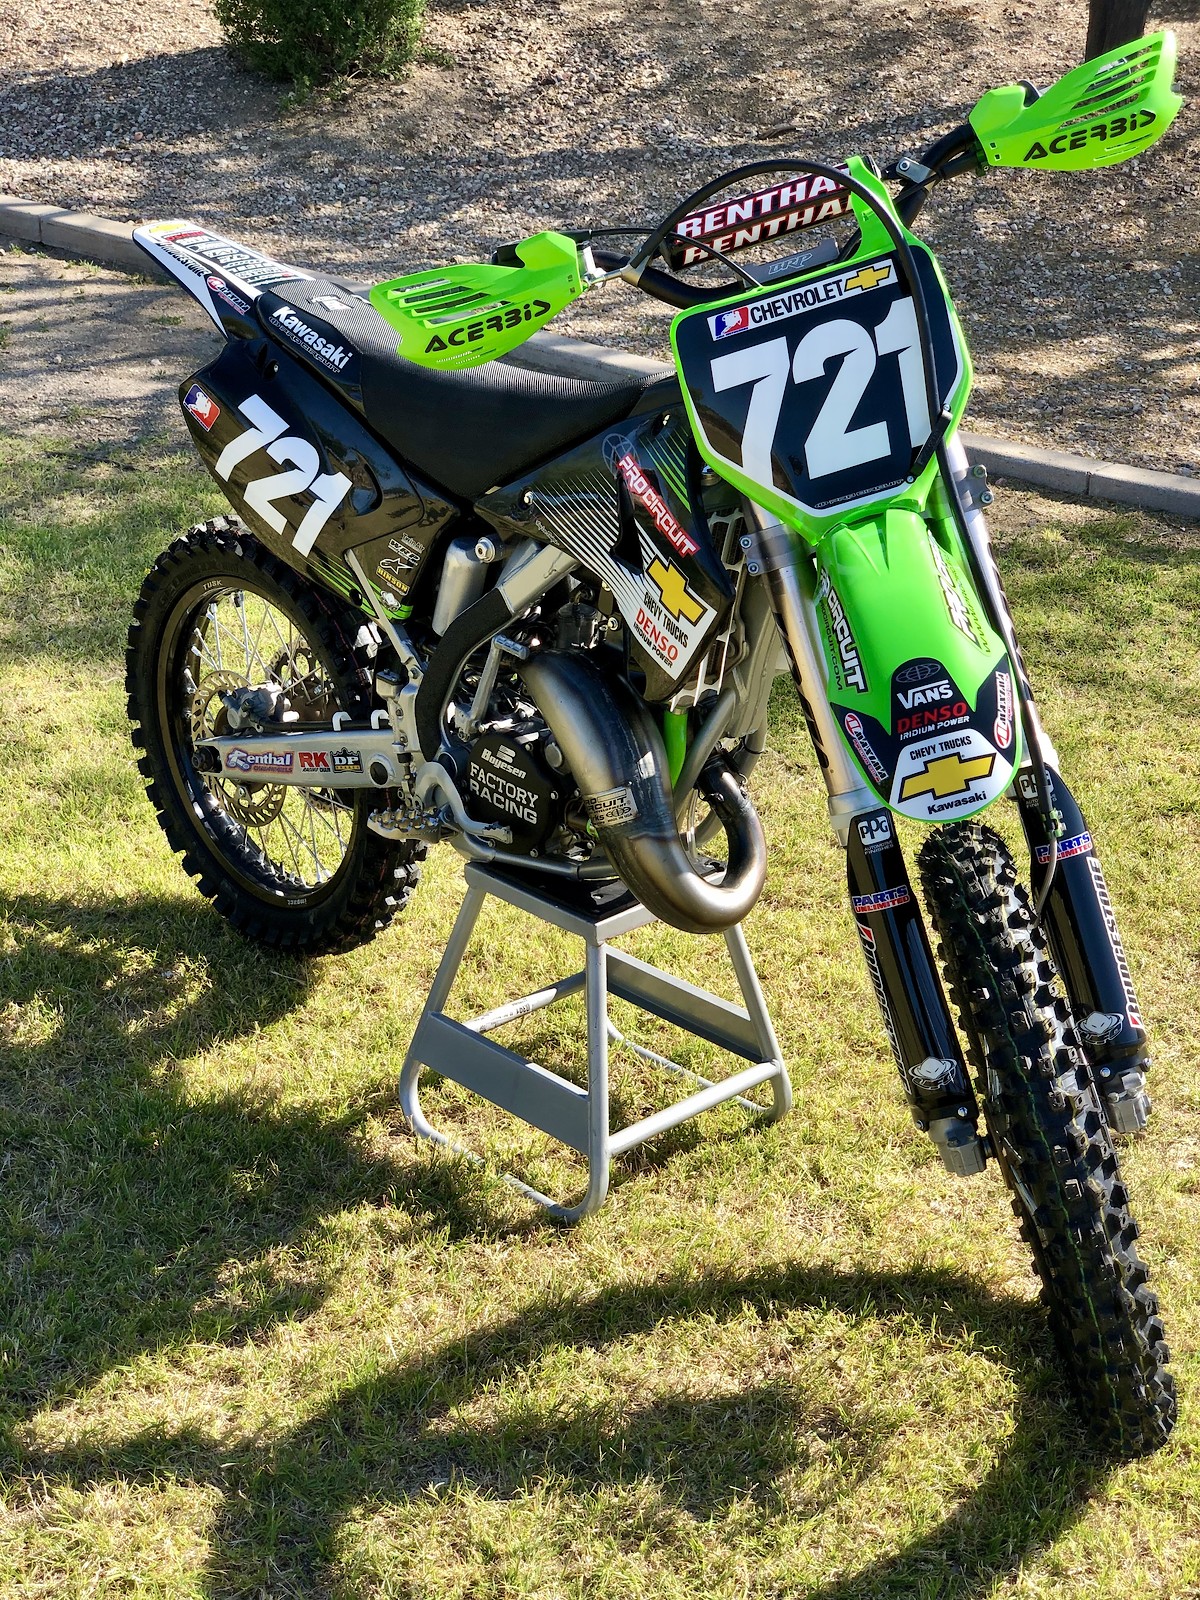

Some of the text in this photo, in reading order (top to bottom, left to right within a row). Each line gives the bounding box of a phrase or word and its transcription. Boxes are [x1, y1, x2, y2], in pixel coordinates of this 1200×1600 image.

[1023, 109, 1156, 161] ACERBIS
[677, 169, 848, 238] RENTHA
[750, 279, 843, 323] CHEVROLET
[272, 306, 353, 369] Kawasaki
[425, 300, 551, 353] ACERBIS
[710, 296, 932, 489] 721
[215, 394, 353, 558] 721
[619, 455, 696, 554] PRO CIRCUIT
[203, 580, 222, 590] TUSK
[635, 607, 678, 661] DENSO
[644, 592, 688, 648] CHEVY TRUCKS
[827, 588, 865, 690] CIRCUIT
[652, 645, 673, 668] POWER
[897, 679, 953, 709] VANS
[897, 702, 968, 734] DENSO
[900, 715, 970, 741] IRIDIUM POWER
[227, 749, 292, 771] Renthal
[298, 752, 330, 768] RK
[334, 756, 359, 765] DP
[481, 748, 527, 779] Boyesen
[910, 736, 972, 761] CHEVY TRUCKS
[470, 761, 539, 808] FACTORY
[470, 778, 538, 824] RACING
[589, 796, 627, 810] RCUIT
[927, 790, 987, 815] Kawasaki
[859, 817, 889, 840] PPG
[852, 885, 908, 906] PARTS
[855, 895, 910, 913] UNLIMITED
[1087, 857, 1145, 1029] BRIDGESTONE
